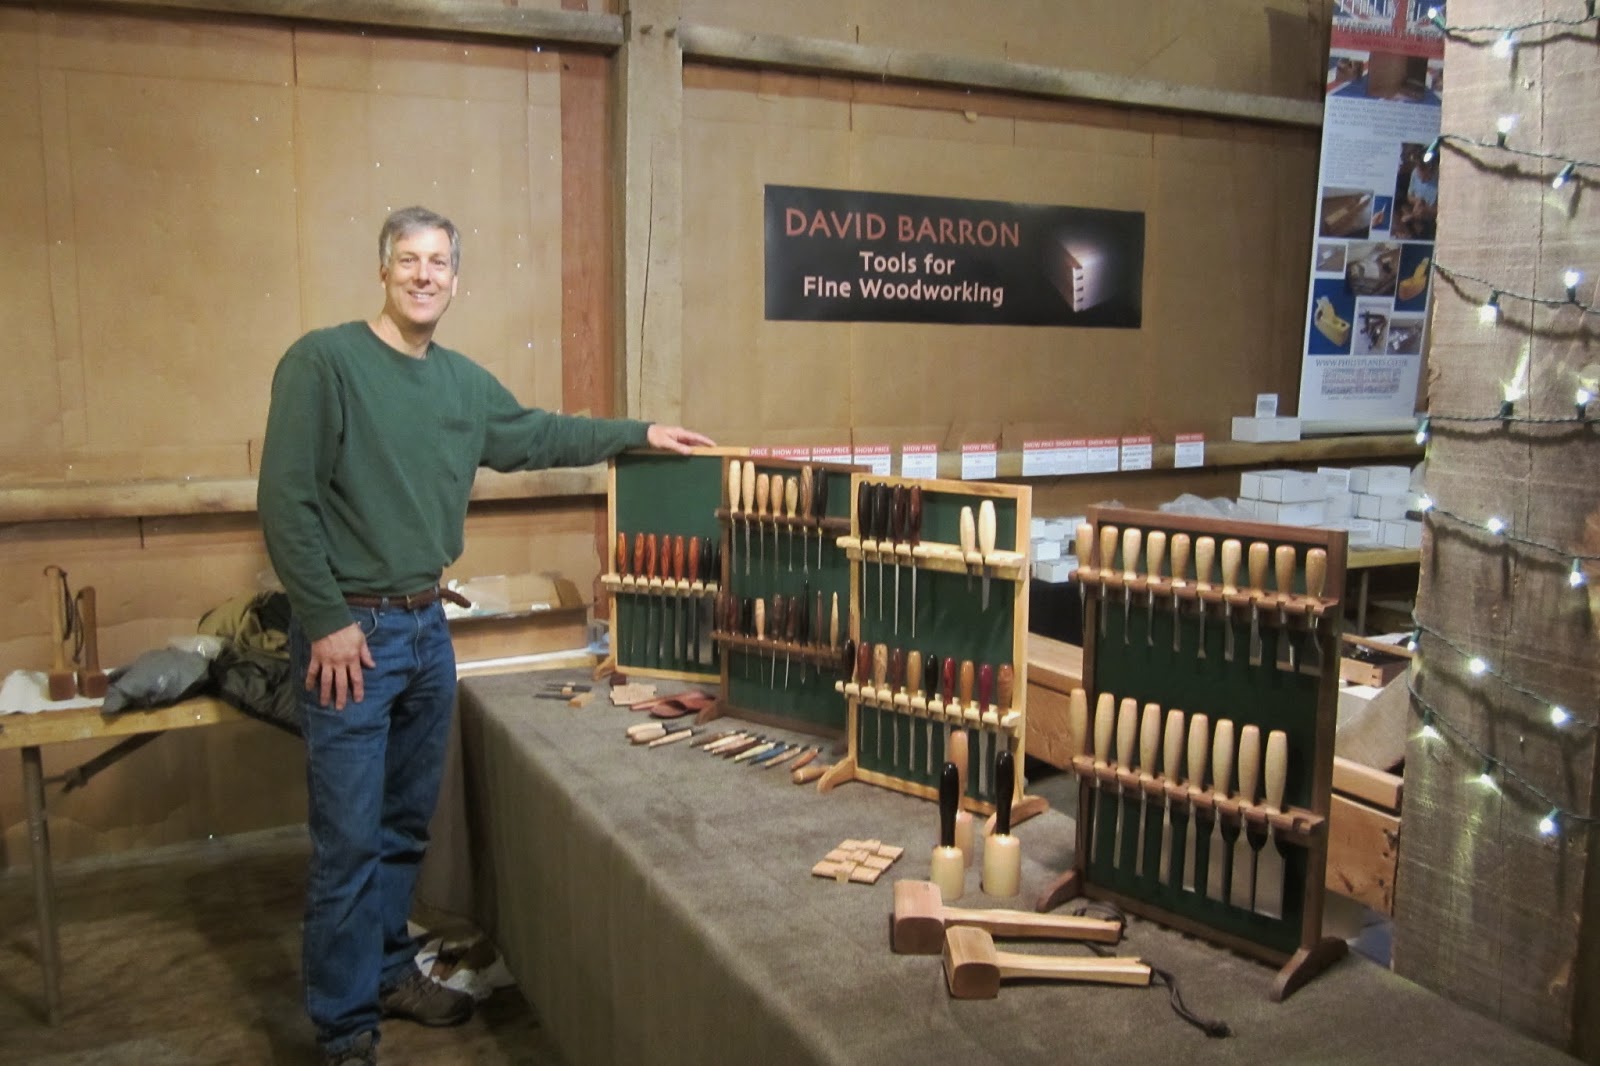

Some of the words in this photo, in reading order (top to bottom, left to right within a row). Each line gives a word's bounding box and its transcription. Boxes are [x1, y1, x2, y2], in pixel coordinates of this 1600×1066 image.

[785, 207, 887, 241] DAVID
[898, 215, 1020, 248] BARRON
[859, 250, 917, 275] Tools
[924, 252, 956, 275] for
[803, 276, 852, 297] Fine
[859, 278, 1004, 308] Woodworking
[751, 447, 768, 456] PRICE
[772, 448, 792, 456] SHOW
[812, 447, 832, 455] SHOW
[833, 446, 849, 454] PRICE
